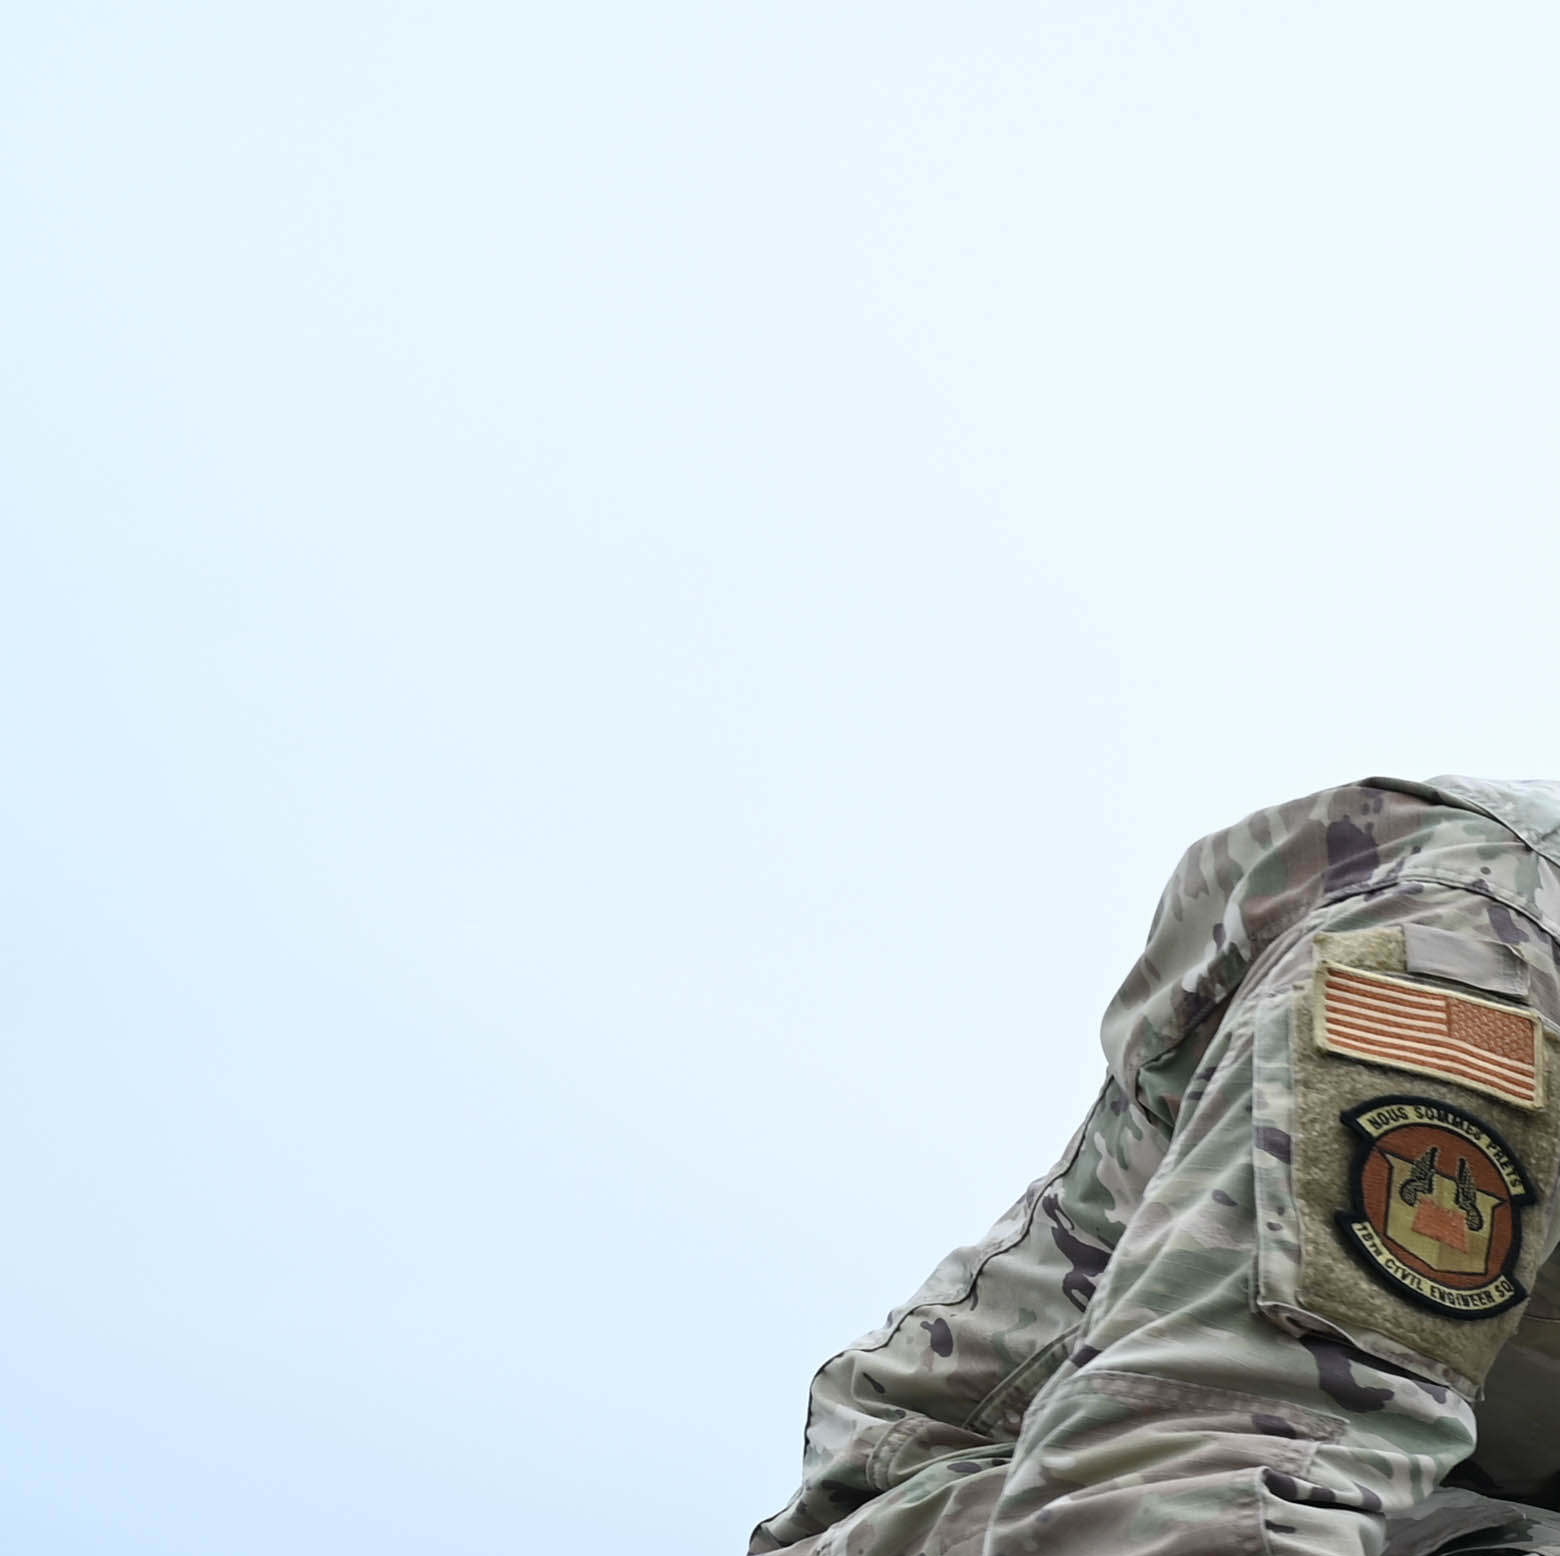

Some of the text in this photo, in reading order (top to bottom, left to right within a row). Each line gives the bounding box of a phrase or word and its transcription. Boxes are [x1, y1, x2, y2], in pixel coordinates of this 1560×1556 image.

[1368, 1106, 1408, 1130] NOUS
[1385, 1258, 1424, 1291] CIVIL
[1430, 1287, 1495, 1308] ENGINEER
[1496, 1282, 1514, 1299] SQ
